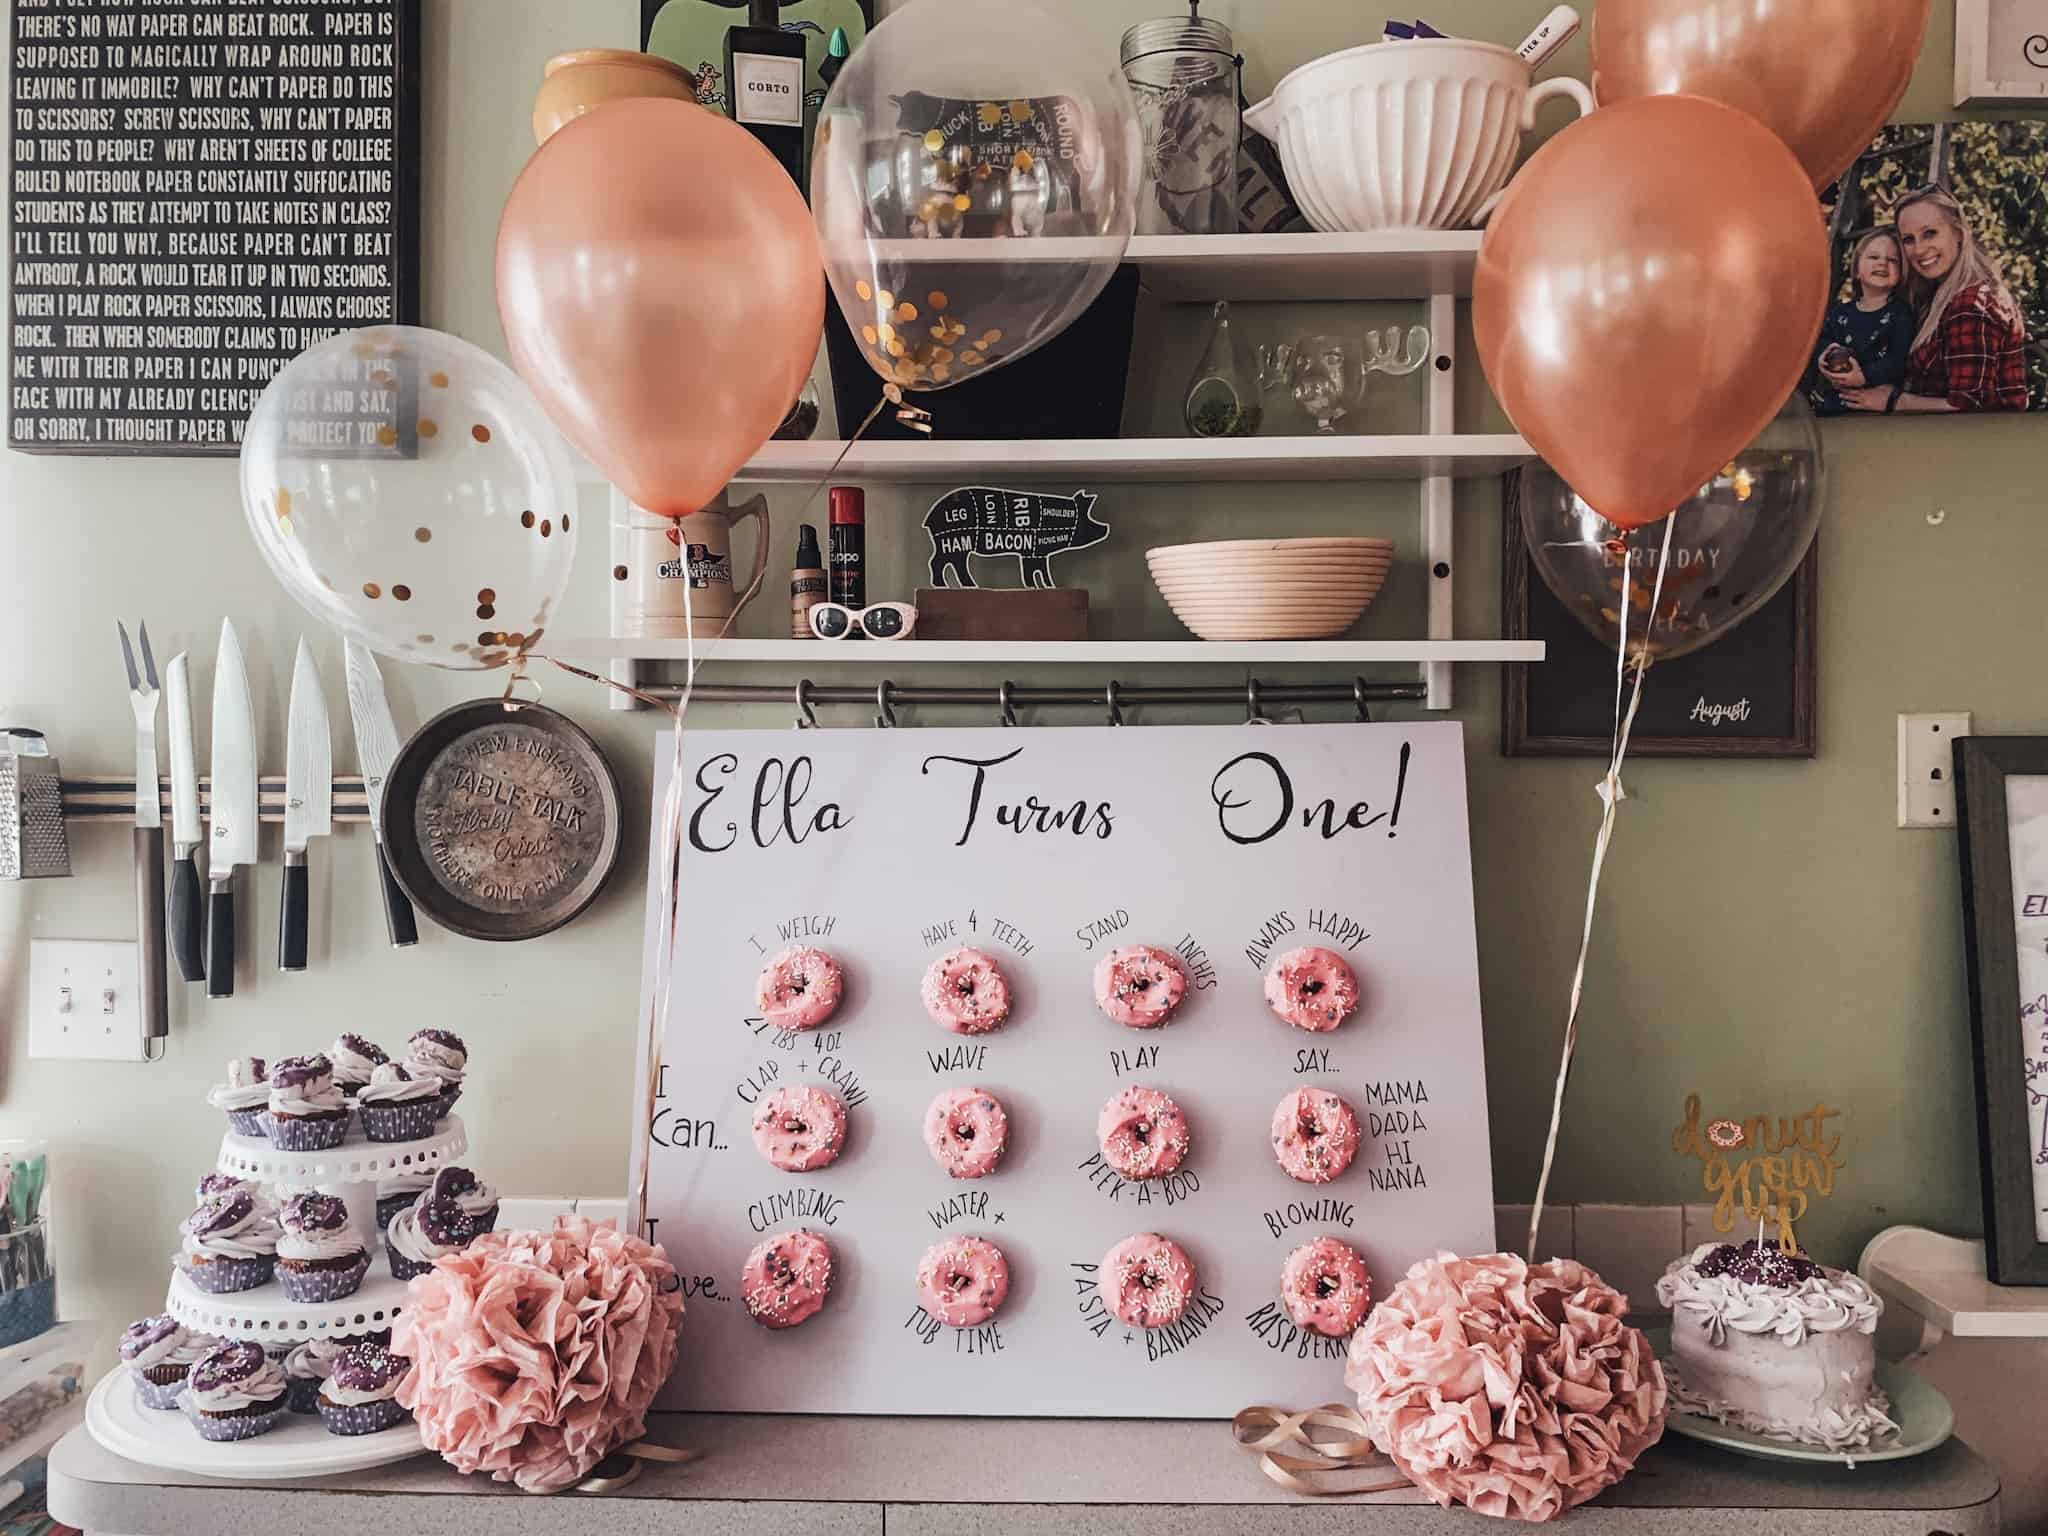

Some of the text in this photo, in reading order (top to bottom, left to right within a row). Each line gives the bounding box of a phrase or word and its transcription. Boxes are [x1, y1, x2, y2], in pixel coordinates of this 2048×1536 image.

[17, 13, 393, 38] THERE'S NO WAY PAPER CAN BEAT ROCK. PAPER IS
[15, 44, 393, 68] SUPPOSED TO MAGICALLY WRAP AROUND ROCK
[15, 76, 393, 99] LEAVING IT IMMOBILE? WHY CAN'T PAPER DO THIS
[748, 81, 790, 95] CORTO
[15, 107, 392, 131] TO SCISSORS? SCREW SCISSORS, WHY CAN'T PAPER
[1054, 104, 1074, 159] ROUND
[15, 139, 393, 162] DO THIS TO PEOPLE? WHY AREN'T SHEETS OF COLLEGE
[14, 170, 392, 193] RULED NOTEBOOK PAPER CONSTANTLY SUFFOCATING
[14, 201, 392, 224] STUDENTS AS THEY ATTEMPT TO TAKE NOTES IN CLASS?
[14, 232, 392, 256] I'LL TELL YOU WHY, BECAUSE PAPER CAN'T BEAT
[14, 263, 391, 287] ANYBODY, ROCK WOULD TEAR IT UP IN TWO SECONDS.
[13, 294, 391, 320] WHEN PLAY ROCK PAPER SCISSORS, ALWAYS CHOOSE
[13, 325, 297, 349] ROCK. THEN WHEN SOMEBODY CLAIMS TO
[13, 355, 232, 380] ME WITH THEIR PAPER CAN
[13, 386, 50, 410] FACE
[54, 387, 95, 409] WITH
[98, 387, 122, 409] MY
[127, 388, 195, 410] ALREADY
[323, 389, 354, 411] AND
[13, 418, 35, 440] OH
[38, 418, 91, 442] SORRY,
[95, 418, 102, 440] I
[104, 418, 174, 441] THOUGHT
[178, 419, 226, 442] PAPER
[945, 508, 968, 523] LEG
[984, 494, 998, 525] LOIN
[1013, 497, 1031, 528] RIB
[1042, 507, 1075, 518] SHOULDER
[941, 534, 973, 554] HAM
[984, 532, 1033, 551] BACON
[1689, 695, 1752, 726] August
[513, 736, 589, 799] ENGLAND
[452, 766, 588, 833] TABLE TALK
[688, 741, 1411, 854] Ella Turns One!
[748, 914, 837, 955] I WEIGH
[920, 908, 1035, 958] HAVE 4 TEETH
[1244, 908, 1372, 971] ALWAYS HAPPY
[1076, 908, 1218, 992] STAND INCHES
[926, 1045, 988, 1075] WAVE
[1109, 1046, 1160, 1077] PLAY
[655, 1064, 671, 1098] I
[736, 1056, 870, 1110] CLAP CRAWL
[1364, 1079, 1429, 1105] MAMA
[1369, 1109, 1428, 1138] DADA
[1384, 1139, 1413, 1166] HI
[1077, 1151, 1201, 1207] PEEK-A-BOO
[1368, 1164, 1427, 1192] NANA
[748, 1187, 846, 1233] CLIMBING
[927, 1191, 989, 1230] WATER
[1263, 1199, 1355, 1239] BLOWING
[1070, 1262, 1225, 1363] PASTA BANANAS
[903, 1304, 1005, 1355] TUB TIME
